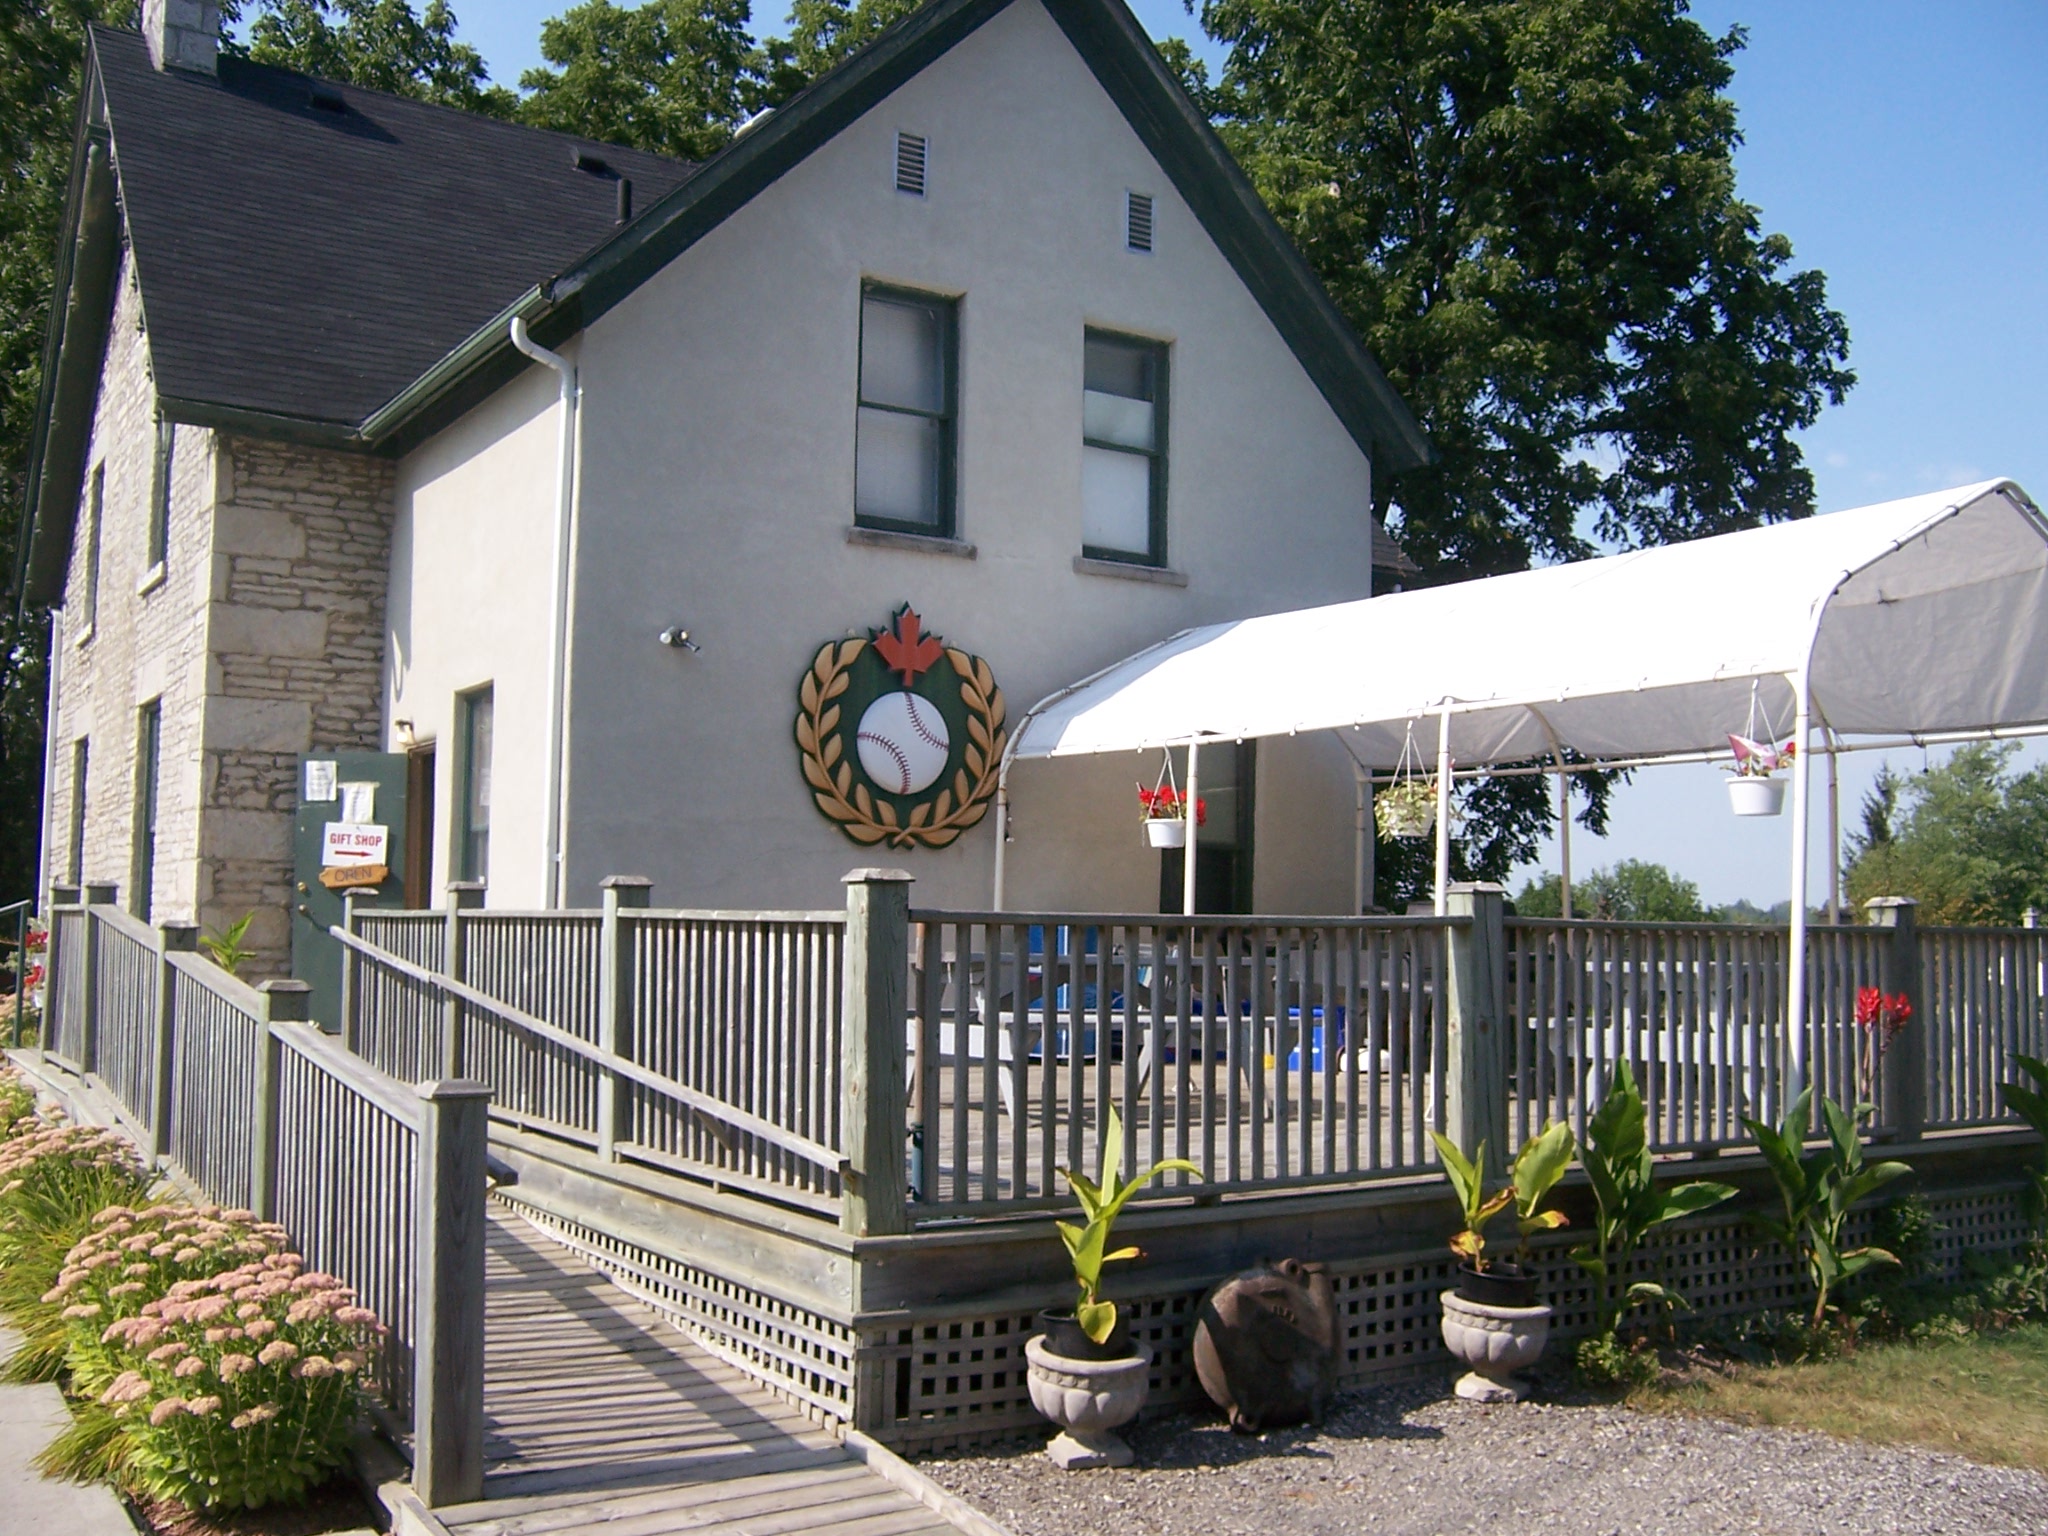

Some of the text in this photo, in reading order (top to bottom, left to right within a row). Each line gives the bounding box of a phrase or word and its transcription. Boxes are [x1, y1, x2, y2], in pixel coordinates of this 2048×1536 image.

[330, 833, 382, 847] GIFT SHOP
[335, 867, 372, 882] OPEN
